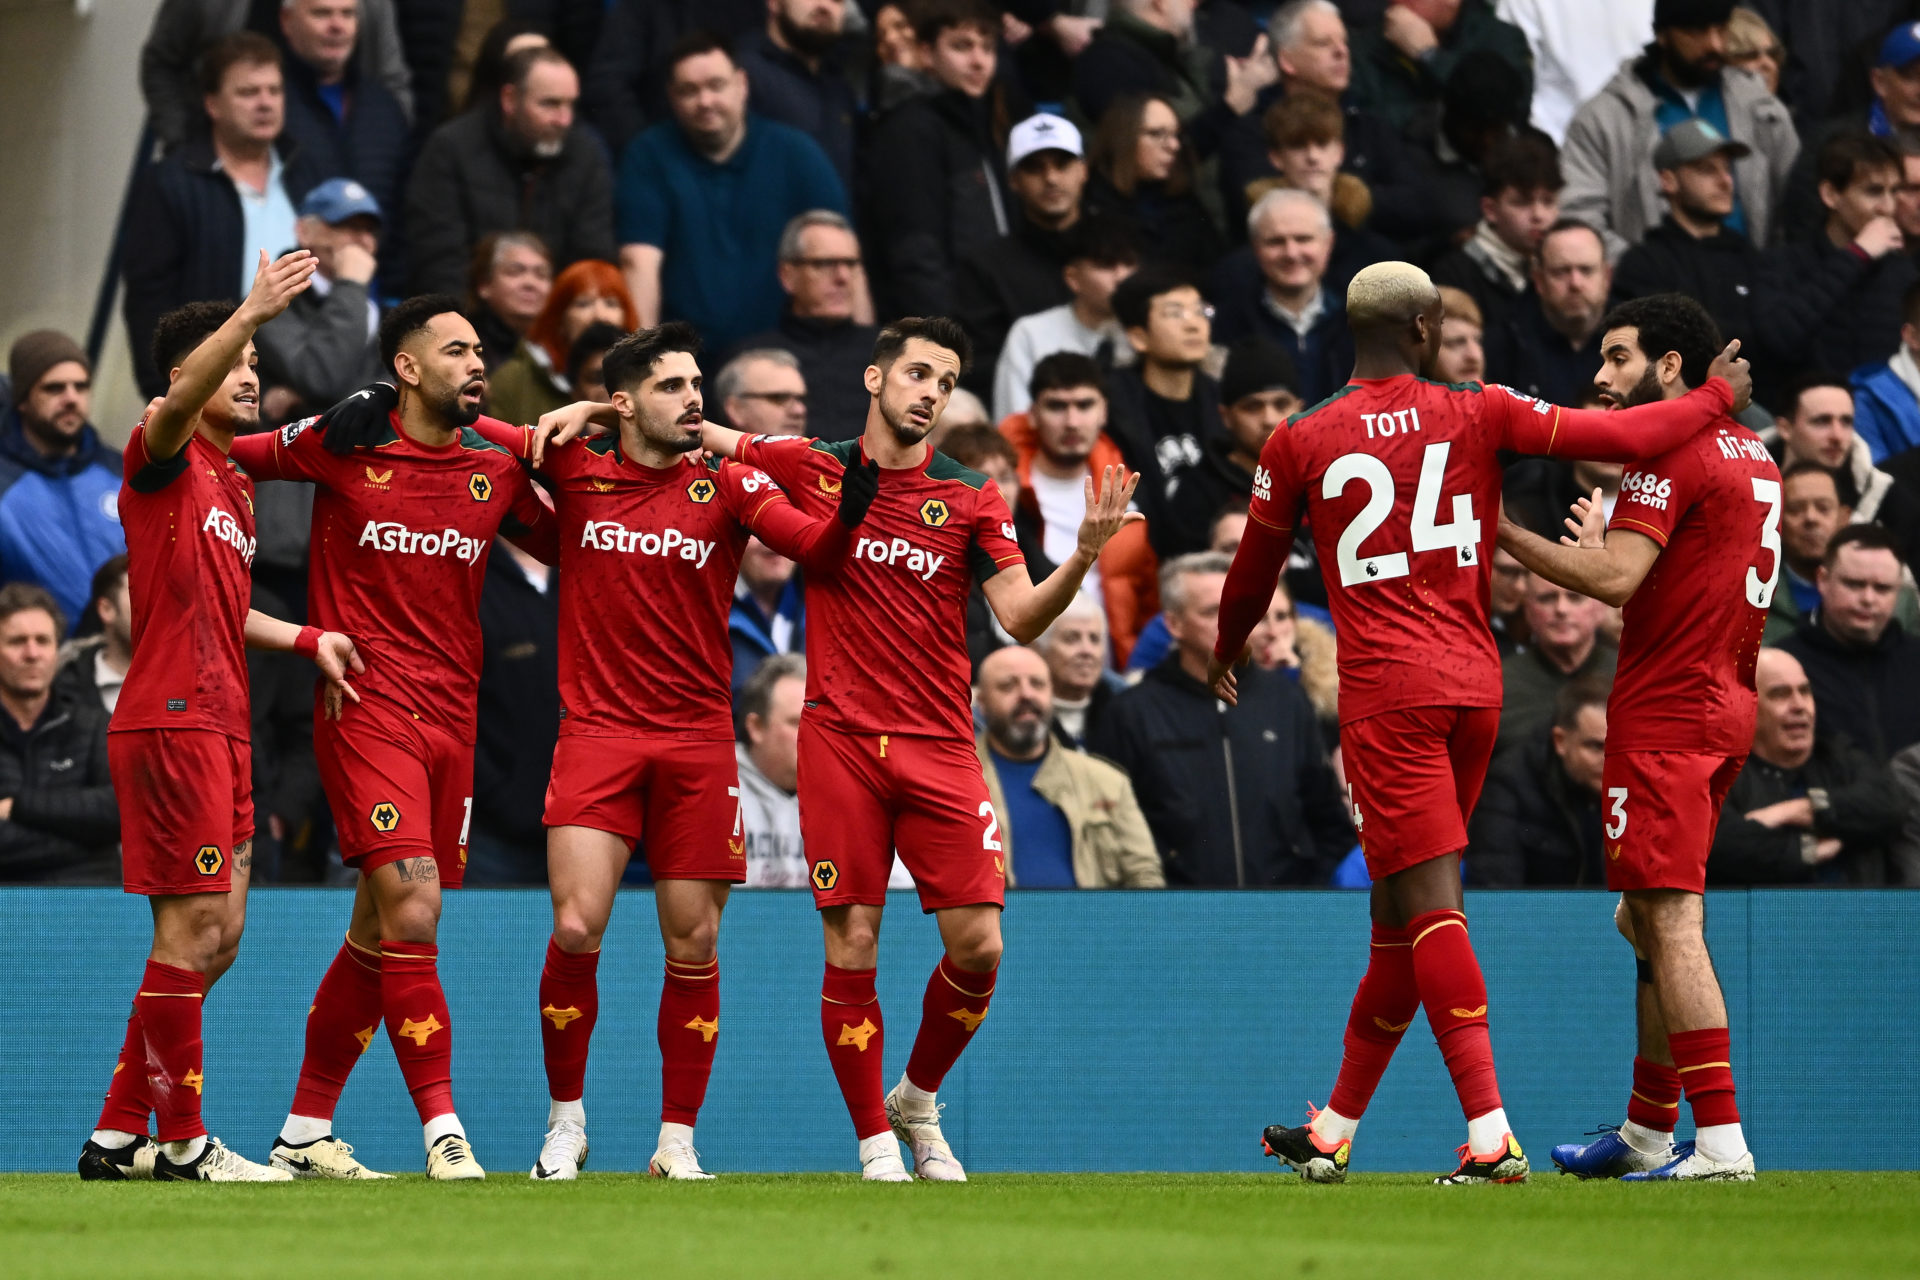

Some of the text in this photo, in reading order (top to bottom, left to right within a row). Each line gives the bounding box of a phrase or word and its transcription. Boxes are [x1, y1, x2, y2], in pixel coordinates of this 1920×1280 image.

[1360, 407, 1420, 439] TOTI
[1621, 471, 1672, 498] 6686
[1628, 491, 1668, 511] .com
[203, 506, 257, 568] AstroP
[1322, 441, 1481, 588] 24
[358, 520, 487, 567] AstroPay
[580, 520, 716, 570] AstroPay
[852, 537, 947, 581] roPay
[1745, 477, 1782, 609] 3
[458, 797, 473, 846] 1
[728, 786, 741, 836] 7
[978, 801, 1002, 851] 2
[1605, 787, 1629, 840] 3
